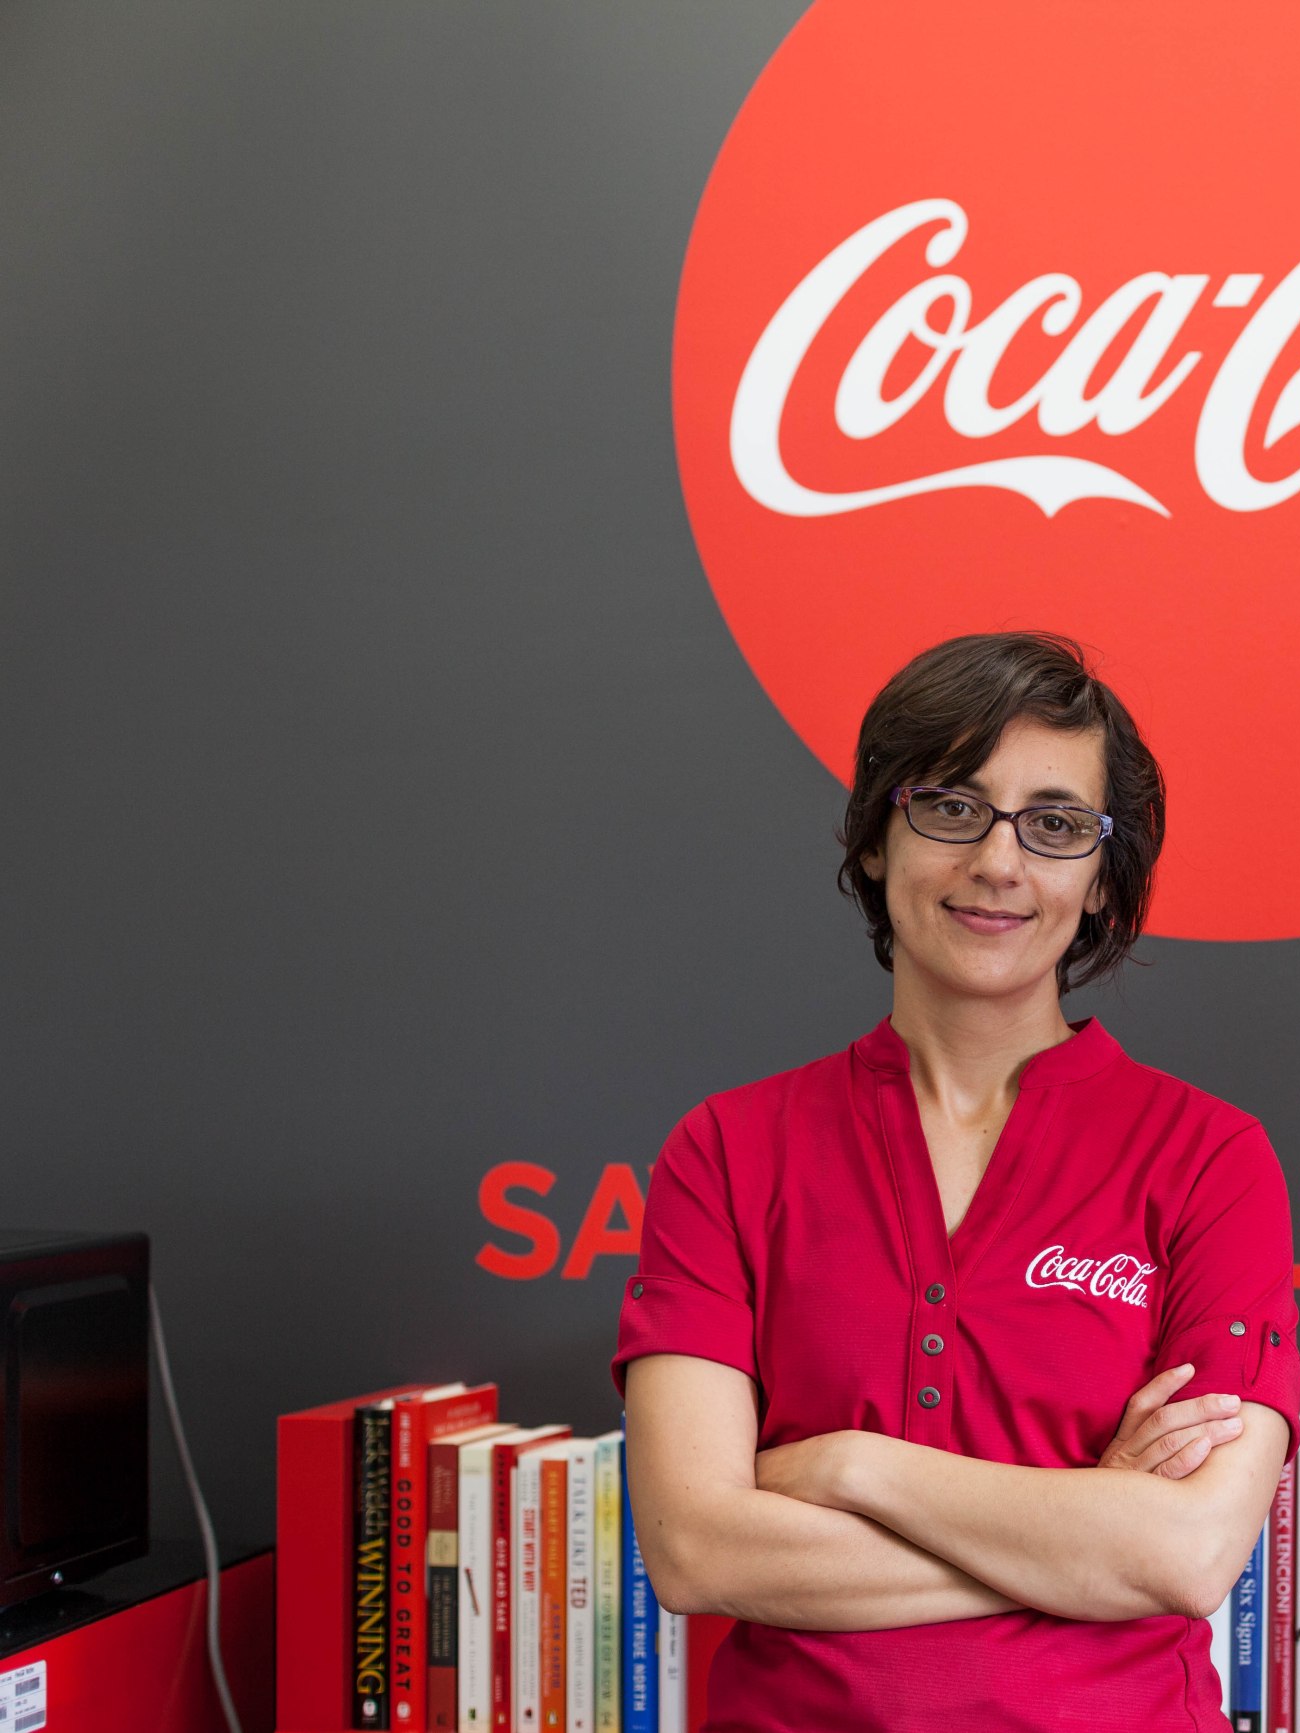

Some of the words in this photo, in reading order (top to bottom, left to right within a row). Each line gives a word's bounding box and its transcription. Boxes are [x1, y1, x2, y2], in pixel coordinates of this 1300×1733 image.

[475, 1161, 655, 1281] SA
[1025, 1245, 1157, 1306] Coca-Cola
[396, 1479, 411, 1549] GOOD
[396, 1564, 411, 1594] TO
[572, 1577, 587, 1609] TED
[633, 1581, 647, 1618] YOUR
[1240, 1578, 1255, 1606] Six
[1276, 1534, 1292, 1614] LENCIONI
[356, 1536, 385, 1695] WINNING
[633, 1622, 647, 1660] TRUE
[1236, 1612, 1256, 1666] Sigma
[396, 1609, 411, 1692] GREAT
[633, 1664, 647, 1712] NORTH
